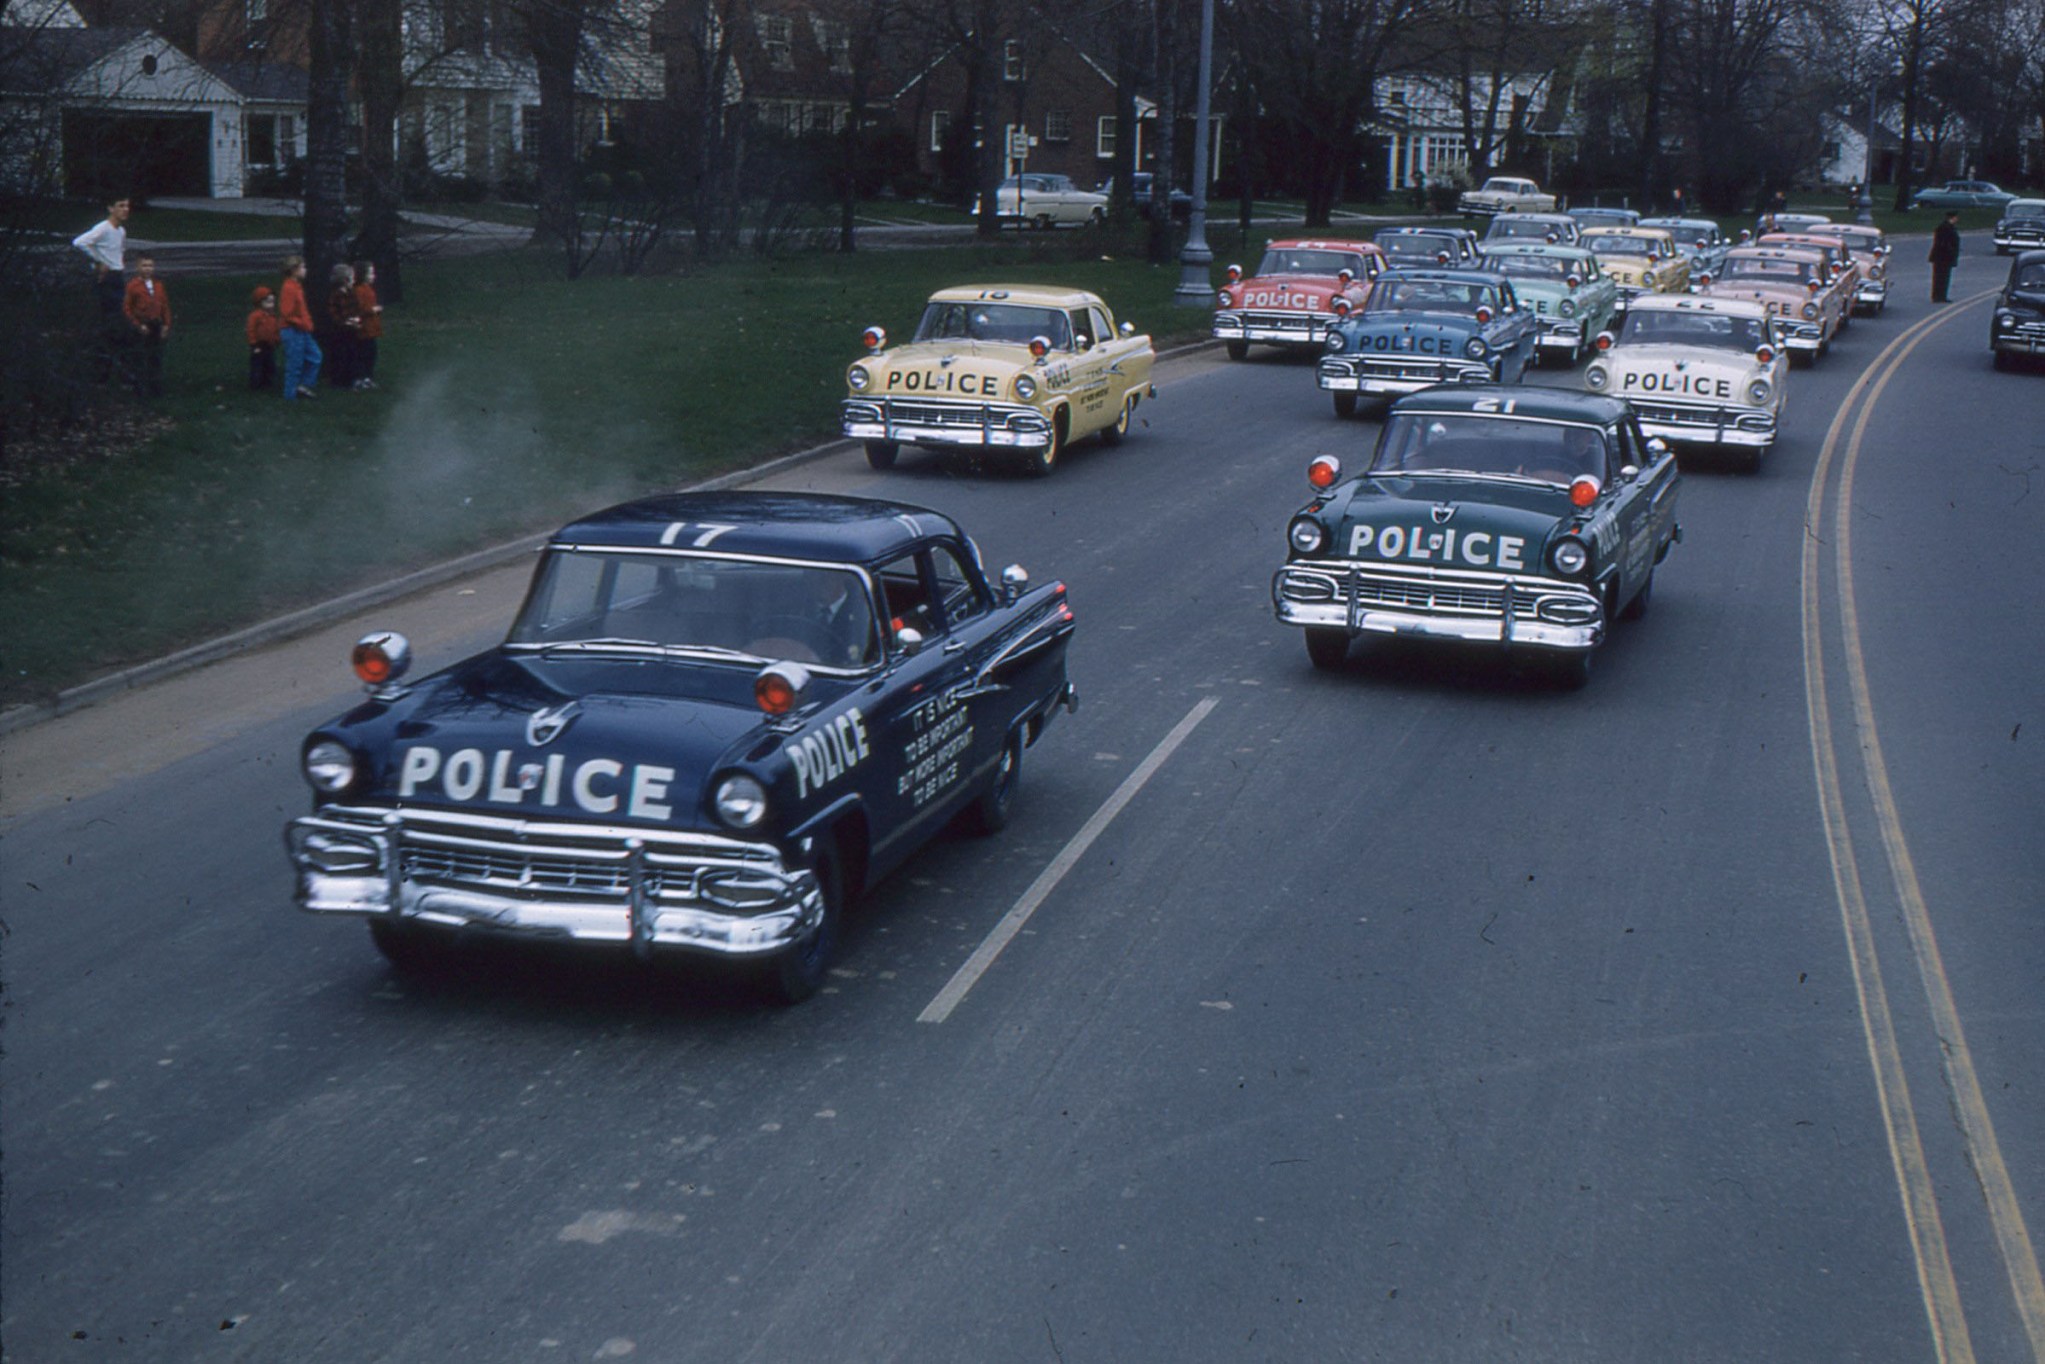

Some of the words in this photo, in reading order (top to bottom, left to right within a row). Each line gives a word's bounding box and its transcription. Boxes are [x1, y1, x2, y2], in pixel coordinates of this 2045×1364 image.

[1244, 291, 1320, 310] POLICE
[1359, 335, 1452, 355] POLICE
[887, 370, 998, 396] POLICE
[1623, 372, 1731, 398] POLICE
[1473, 397, 1516, 413] 21
[660, 522, 739, 547] 17
[1348, 525, 1525, 570] POLICE
[786, 707, 870, 799] POLICE
[398, 746, 676, 820] POLICE
